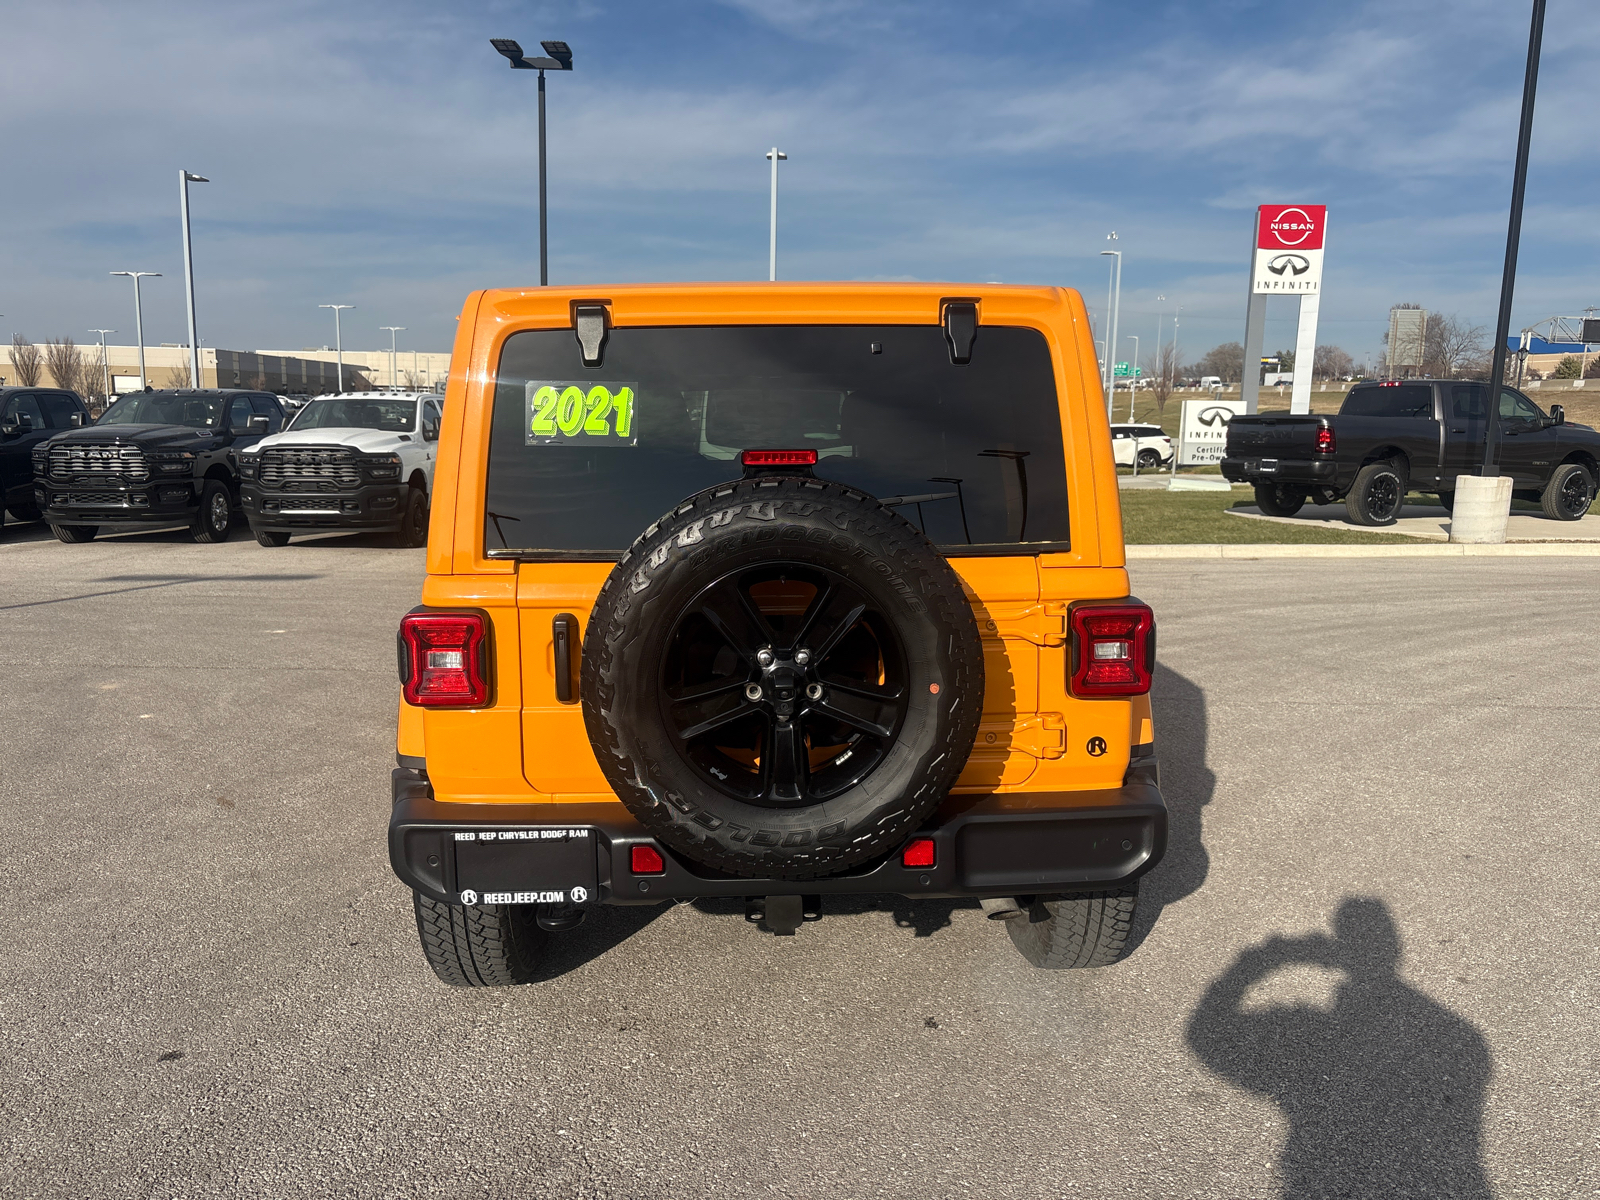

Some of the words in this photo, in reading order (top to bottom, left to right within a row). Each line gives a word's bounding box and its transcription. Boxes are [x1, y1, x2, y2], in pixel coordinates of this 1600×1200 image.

[1257, 281, 1317, 290] INFINITI
[531, 385, 634, 437] 2021
[1189, 431, 1223, 439] INFIN
[1196, 446, 1228, 454] Certifie
[688, 525, 929, 614] BRIDGESTONE
[663, 789, 848, 848] DUELER
[454, 832, 476, 841] REED
[478, 832, 497, 840] JEEP
[498, 830, 539, 840] CHRYSLER
[569, 829, 588, 838] RAM
[483, 891, 564, 904] REEDJEEP.COM
